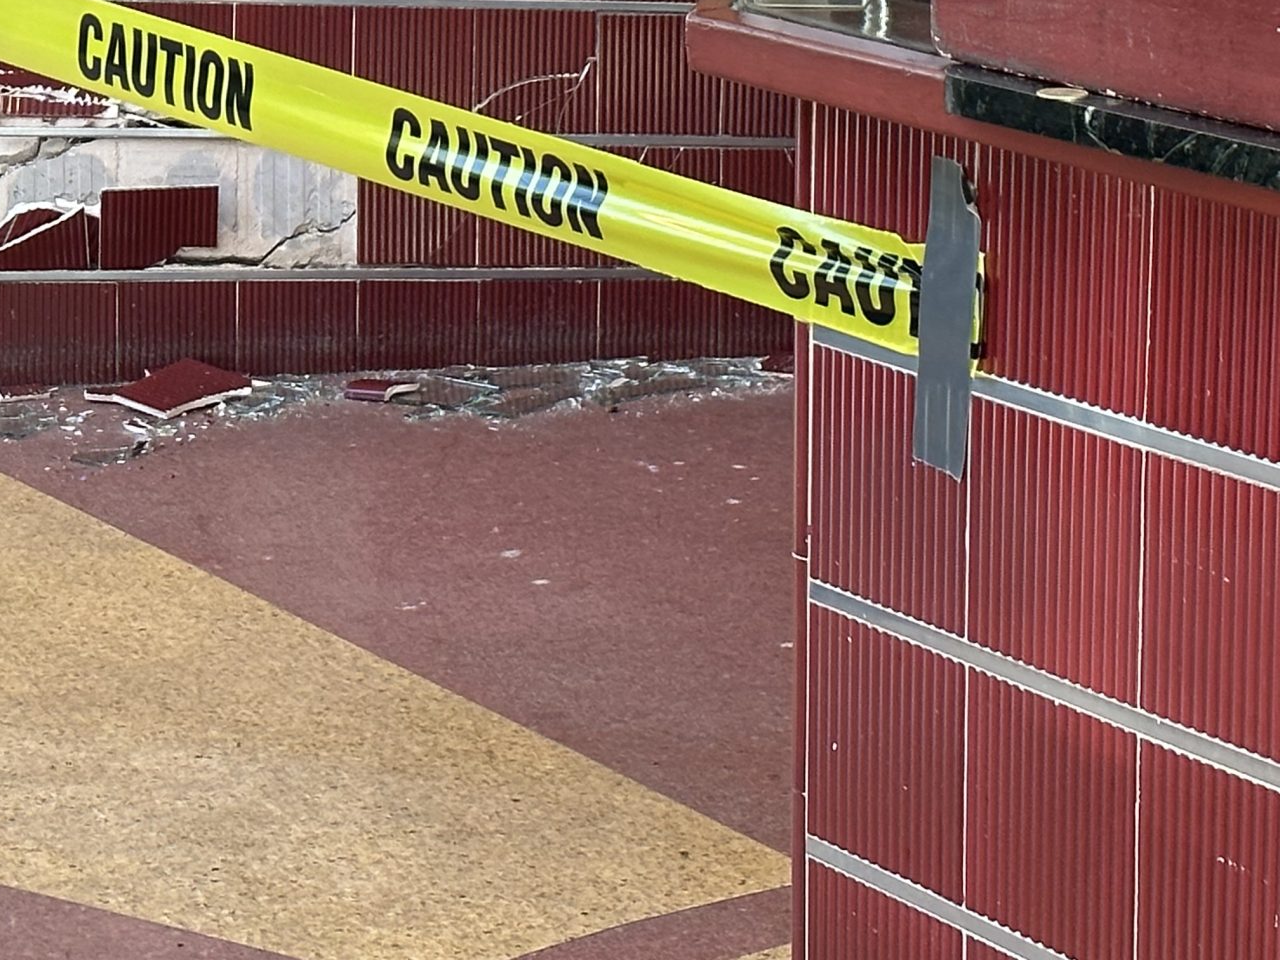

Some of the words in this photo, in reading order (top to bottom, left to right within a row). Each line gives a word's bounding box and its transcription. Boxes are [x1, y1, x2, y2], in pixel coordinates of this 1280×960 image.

[77, 13, 254, 132] CAUTION
[386, 107, 610, 240] CAUTION
[769, 226, 923, 338] CAUT
